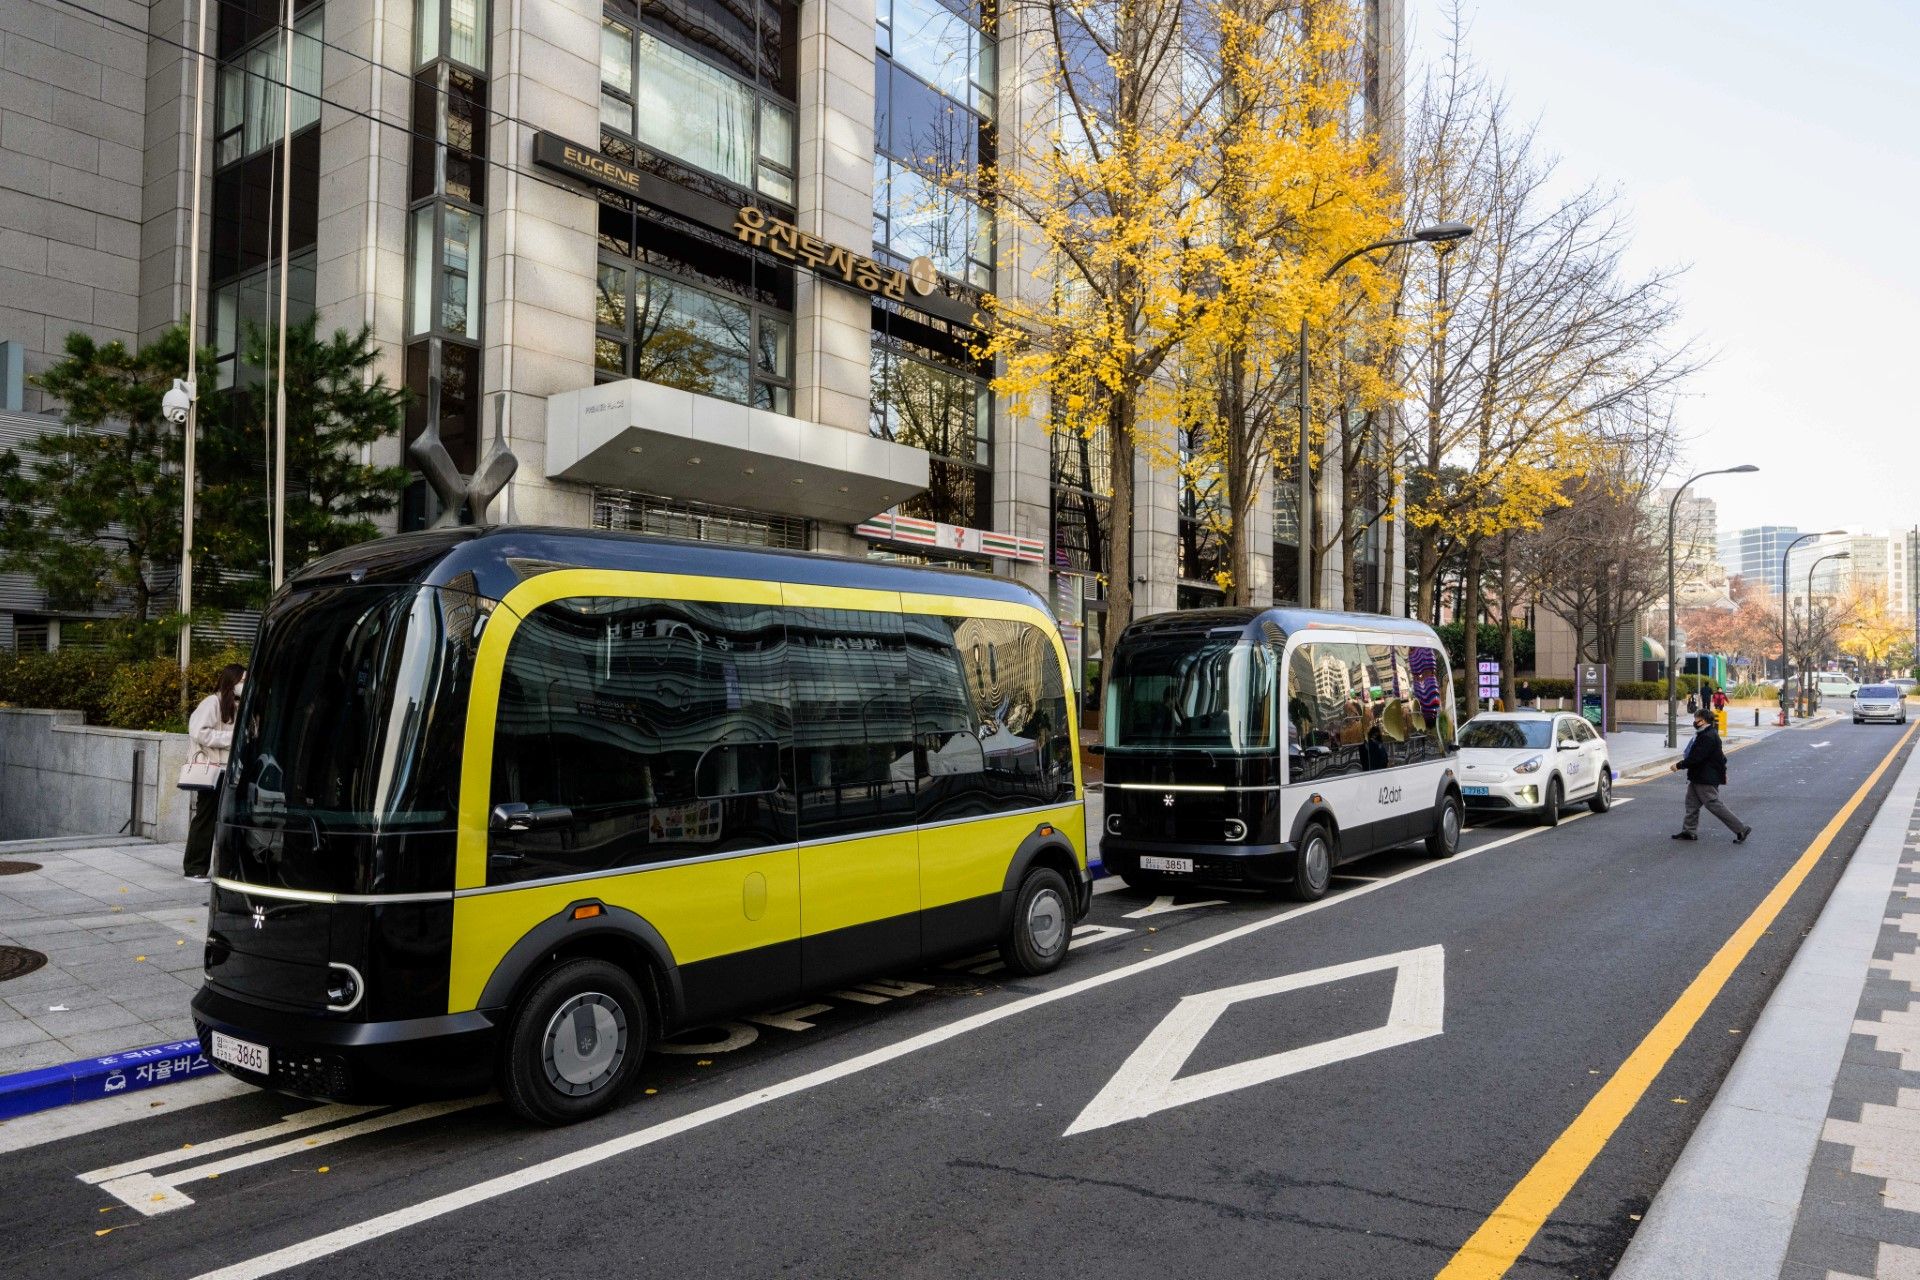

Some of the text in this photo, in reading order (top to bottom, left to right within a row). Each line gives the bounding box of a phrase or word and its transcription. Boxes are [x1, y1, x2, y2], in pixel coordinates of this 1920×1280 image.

[563, 146, 640, 187] EUGENE
[733, 206, 907, 302] 유진투자증권
[1378, 785, 1402, 805] 42dot
[1165, 859, 1187, 870] 3851
[135, 1054, 209, 1082] 자율버스
[236, 1043, 262, 1069] 3865
